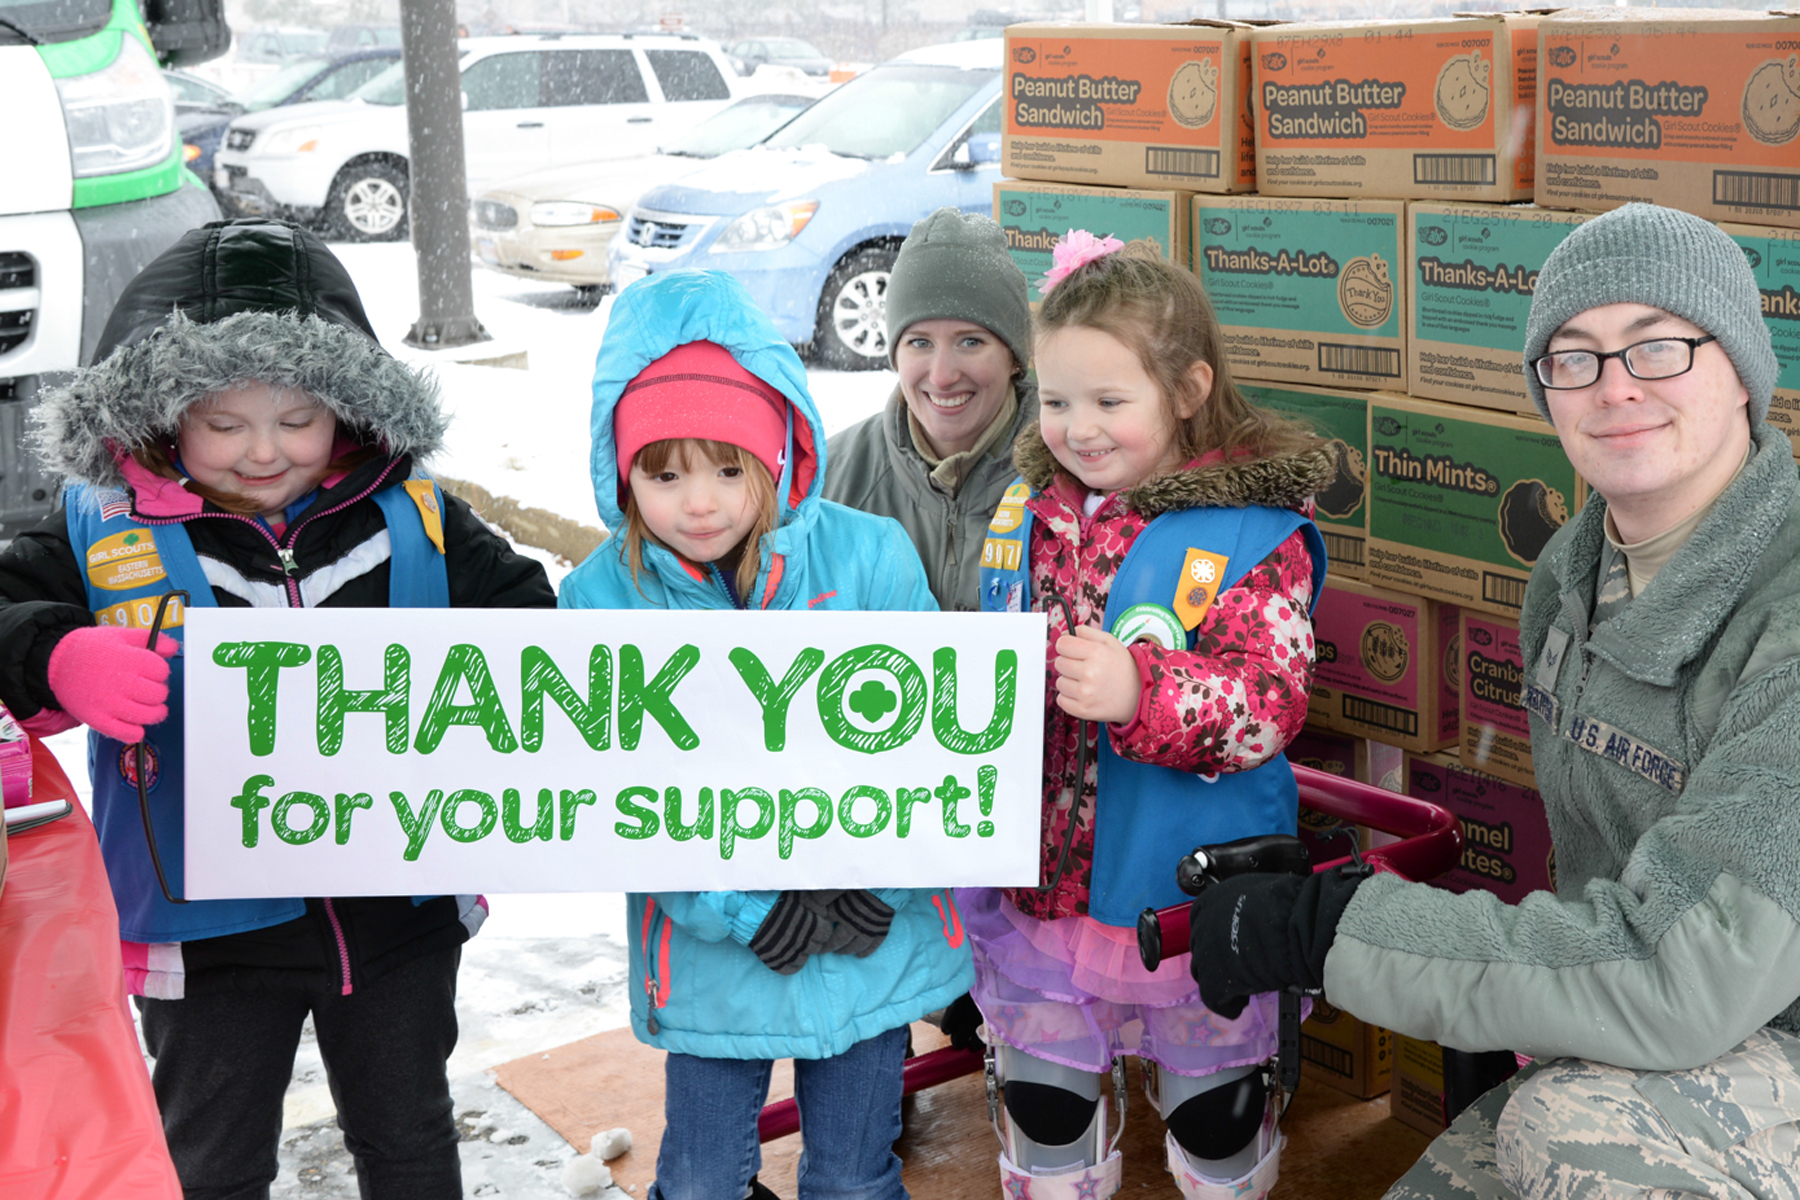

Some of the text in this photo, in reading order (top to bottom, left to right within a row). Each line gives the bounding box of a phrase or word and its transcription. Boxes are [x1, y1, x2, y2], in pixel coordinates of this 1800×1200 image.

[1461, 39, 1491, 48] 007007
[1587, 54, 1596, 62] girl
[1014, 77, 1138, 100] Peanut Butter
[1265, 84, 1402, 106] Peanut Butter
[1550, 84, 1703, 111] Peanut Butter
[1018, 103, 1102, 126] Sandwich
[1106, 107, 1116, 116] Girl
[1117, 107, 1135, 116] Scout
[1368, 113, 1381, 122] Girl
[1381, 113, 1400, 122] Scout
[1271, 111, 1364, 135] Sandwich
[1555, 116, 1657, 144] Sandwich
[1663, 121, 1741, 133] Girl Scout Cookies®
[1546, 163, 1659, 181] Help her build a lifetime of skills
[1367, 218, 1394, 226] 007021
[1458, 235, 1468, 243] girl
[1207, 250, 1336, 274] Thanks-A-Lot®
[1208, 278, 1220, 287] Girl
[1220, 279, 1240, 288] Scout
[1346, 287, 1385, 303] Thank You
[1421, 291, 1434, 302] Girl
[1434, 293, 1455, 305] Scout
[1375, 449, 1497, 493] Thin Mints®
[1374, 481, 1386, 491] Girl
[1386, 483, 1409, 497] Scout
[89, 541, 155, 563] GIRL SCOUTS
[117, 559, 149, 573] EASTERN
[1369, 547, 1479, 581] Help her build a lifetime of skills
[108, 565, 164, 585] MASSACHUSETTS
[1388, 606, 1416, 618] 007027
[211, 641, 1018, 756] THANK YOU
[1472, 679, 1521, 706] Citrus
[1570, 717, 1677, 790] U.S. AIR FORCE
[230, 764, 998, 862] for your support!
